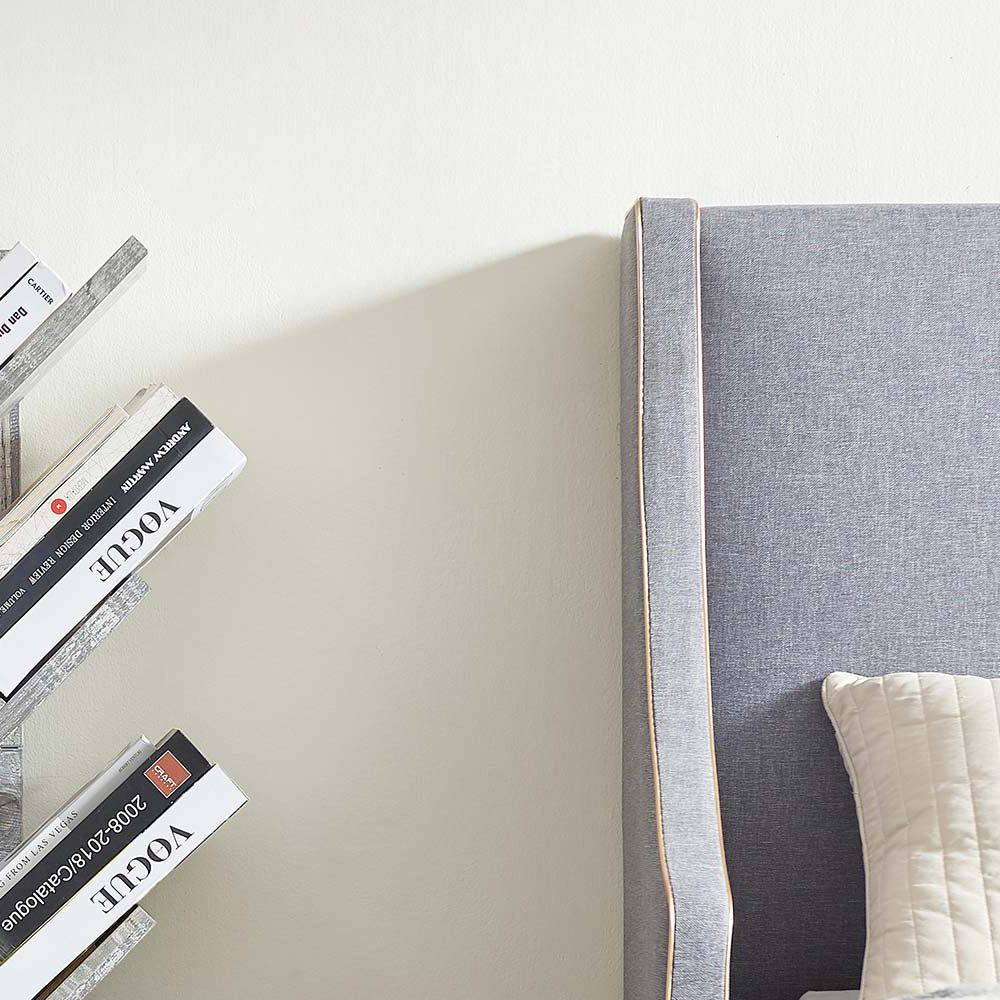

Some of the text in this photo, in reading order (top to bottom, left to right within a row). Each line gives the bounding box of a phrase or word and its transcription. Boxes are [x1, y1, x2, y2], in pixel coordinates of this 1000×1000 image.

[26, 277, 55, 306] CARTIER
[7, 305, 29, 326] Dan
[152, 420, 192, 463] ANDREW
[120, 456, 155, 494] MARTIN
[80, 495, 118, 532] INTERIOR
[54, 528, 84, 559] DESIGN
[88, 499, 181, 583] VOGUE
[28, 555, 57, 586] REVIEW
[153, 764, 178, 792] CRAFT
[1, 793, 148, 932] 2008-2018/Catalogue
[4, 854, 33, 883] FROM
[29, 837, 51, 858] LAS
[47, 808, 83, 839] VEGAS
[89, 824, 194, 915] VOGUE
